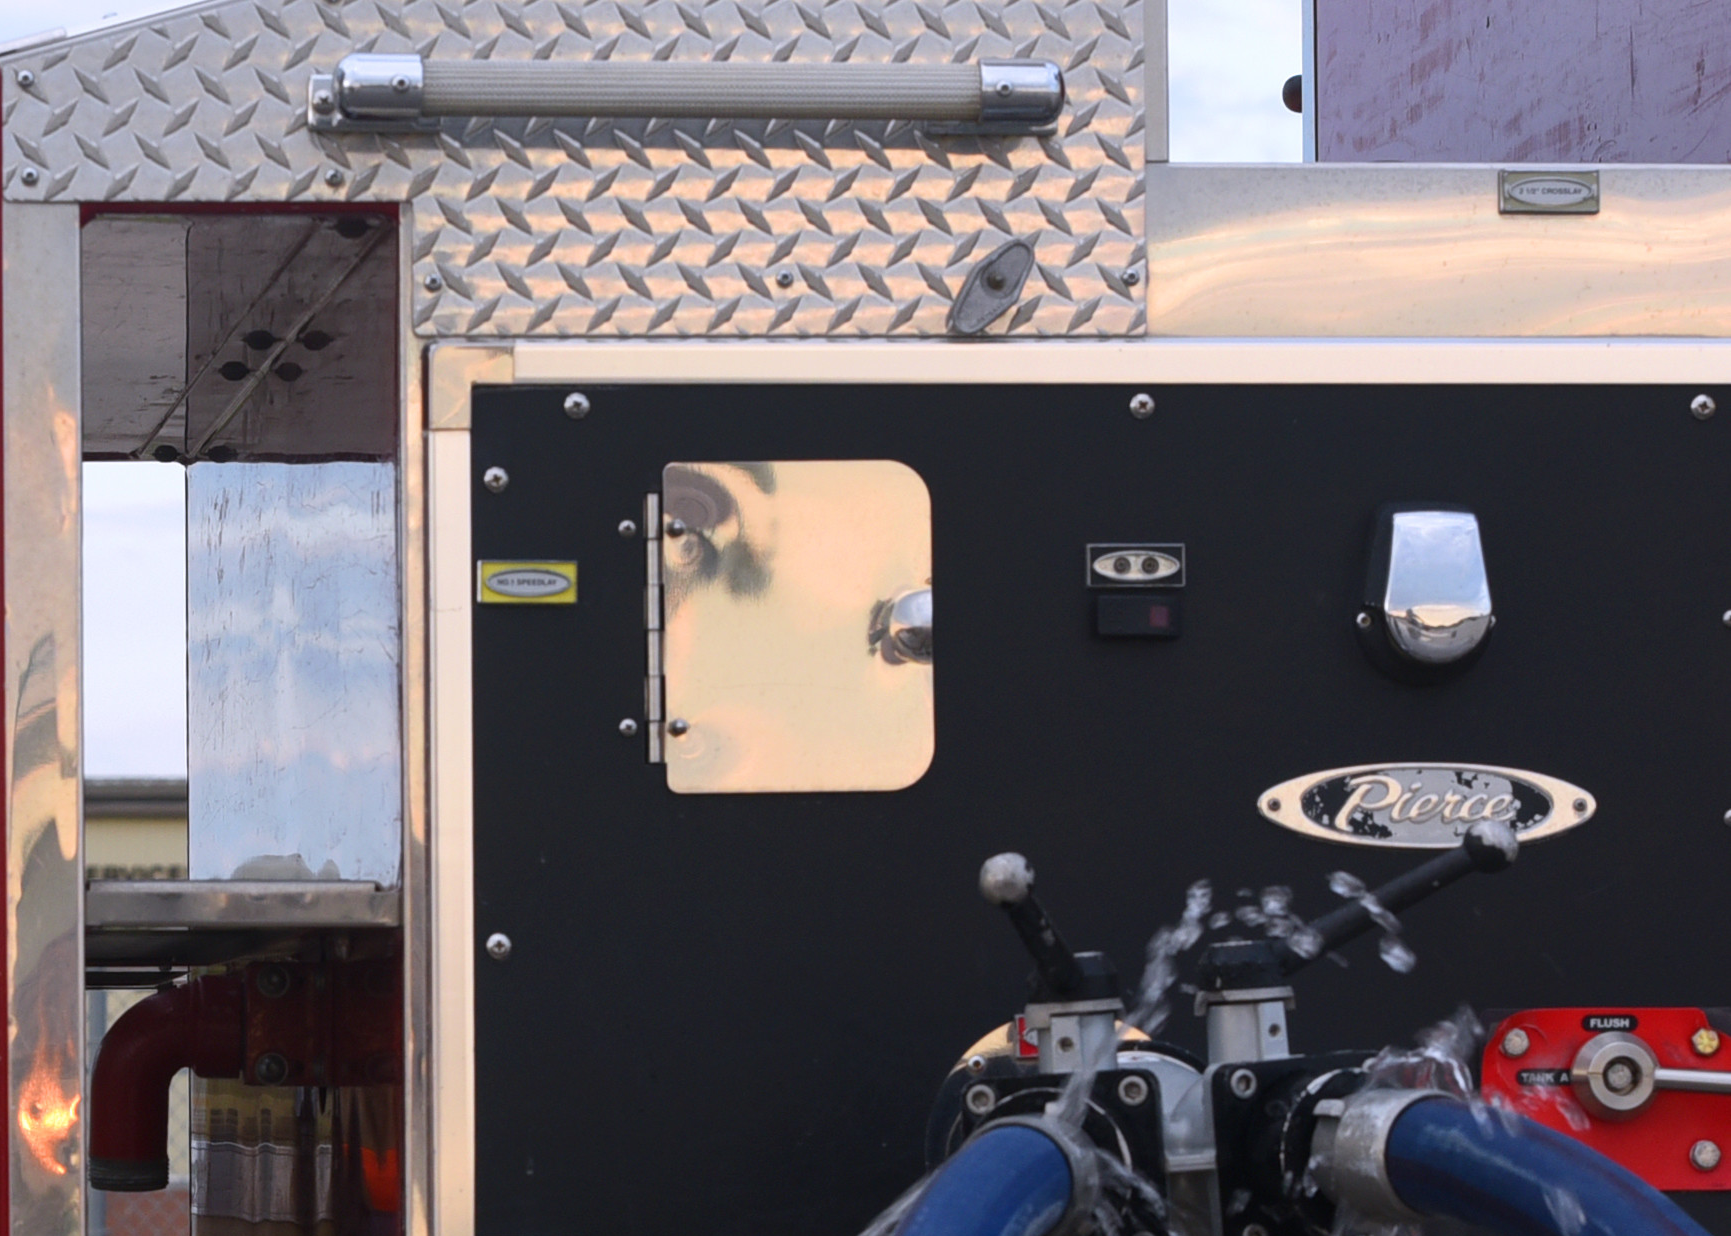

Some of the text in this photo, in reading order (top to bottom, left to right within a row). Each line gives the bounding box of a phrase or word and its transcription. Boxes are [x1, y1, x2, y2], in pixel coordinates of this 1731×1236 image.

[1541, 187, 1583, 195] CROSSLAY
[516, 578, 557, 586] SPEEDLAY
[1333, 774, 1516, 832] Pierce
[1589, 1017, 1631, 1029] FLUSH
[1520, 1072, 1555, 1083] TANK
